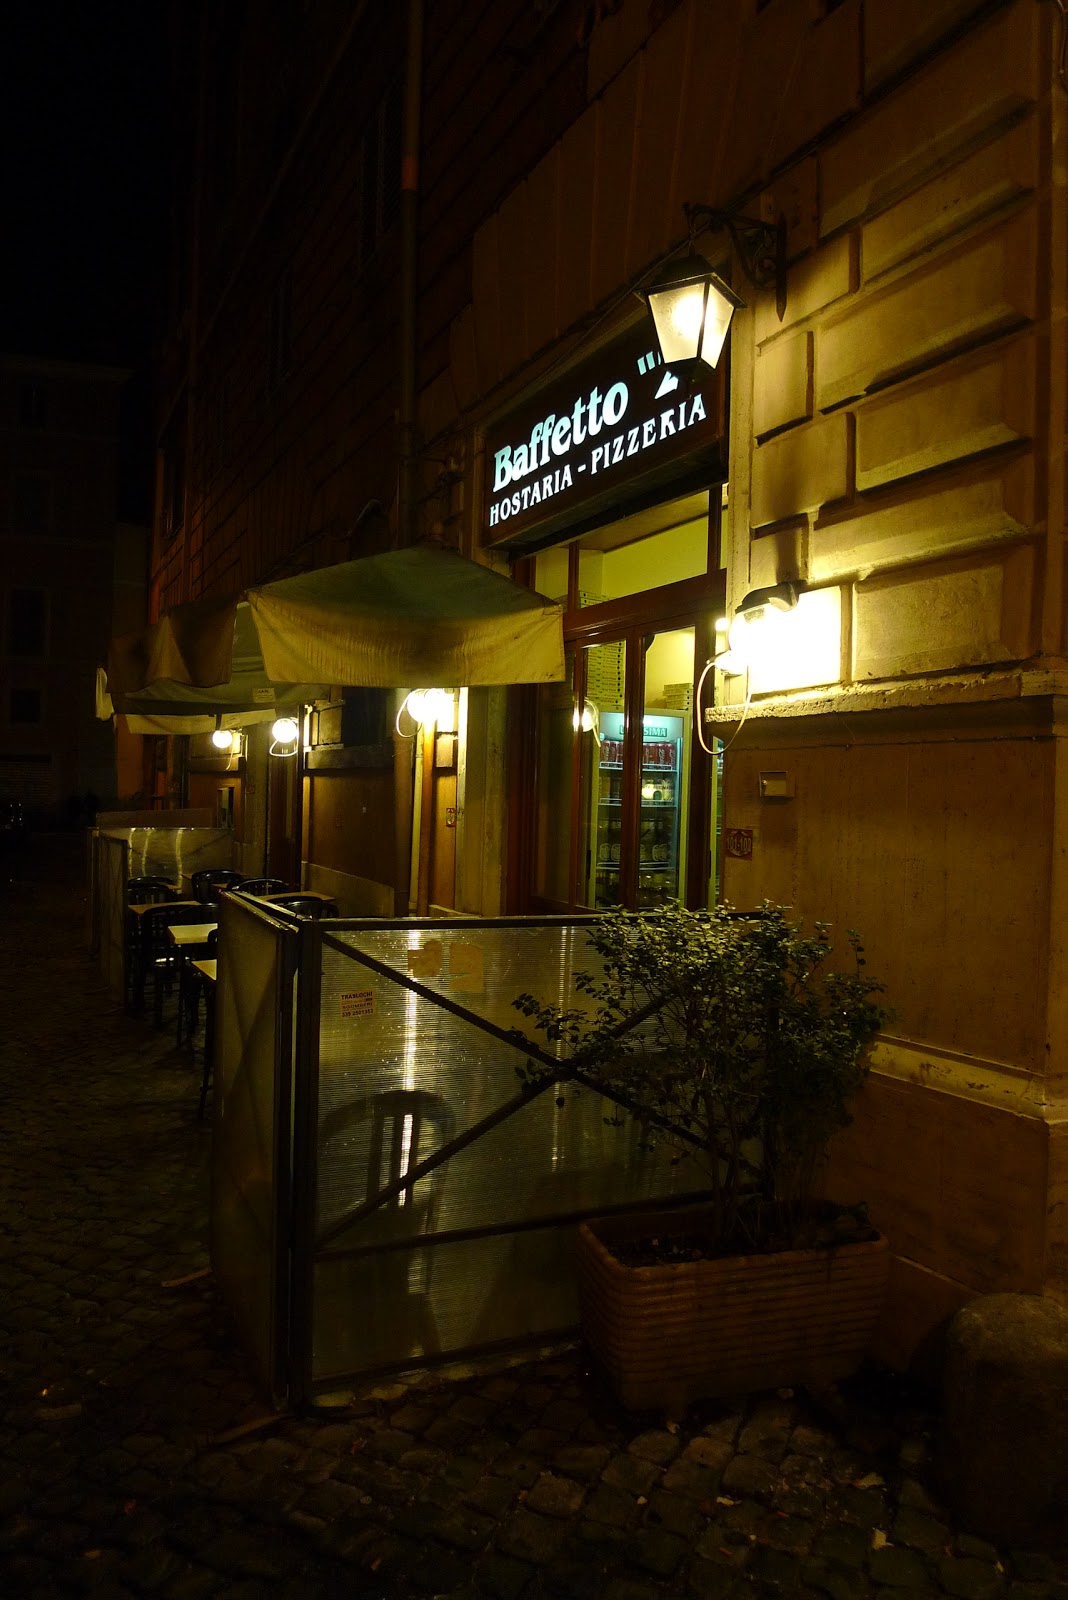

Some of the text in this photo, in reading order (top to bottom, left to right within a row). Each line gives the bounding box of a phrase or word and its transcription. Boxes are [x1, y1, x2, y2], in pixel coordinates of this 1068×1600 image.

[489, 464, 573, 527] HOSTARIA
[590, 393, 707, 475] PIZZERIA
[493, 381, 628, 492] Baffetto
[341, 991, 373, 1000] TRASLOCHI
